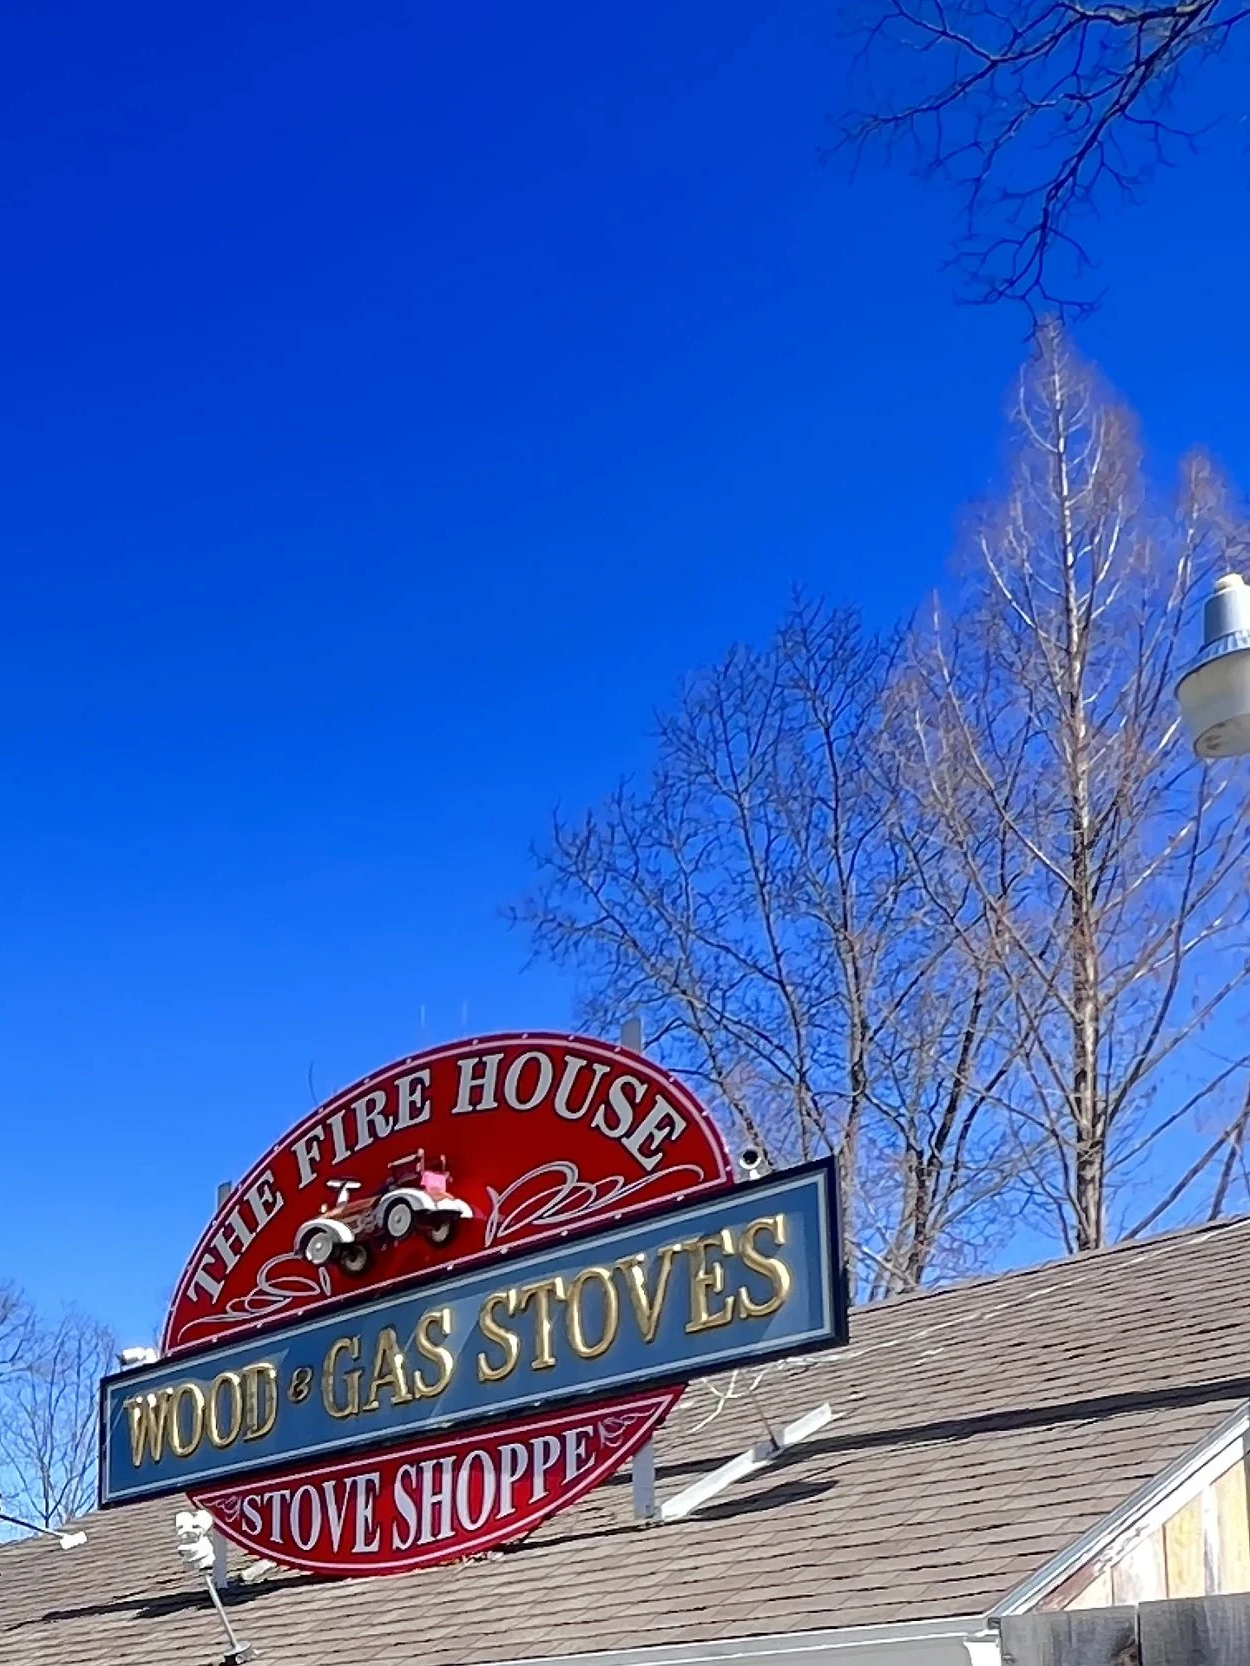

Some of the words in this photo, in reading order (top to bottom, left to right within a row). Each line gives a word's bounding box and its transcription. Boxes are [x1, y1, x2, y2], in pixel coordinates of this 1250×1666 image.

[186, 1174, 284, 1304] THE
[291, 1068, 431, 1189] FIRE
[452, 1051, 687, 1171] HOUSE
[124, 1361, 277, 1467] WOOD
[321, 1307, 453, 1418] GAS
[478, 1213, 792, 1381] STOVES
[242, 1472, 382, 1553] STOVE
[393, 1425, 595, 1550] SHOPPE
